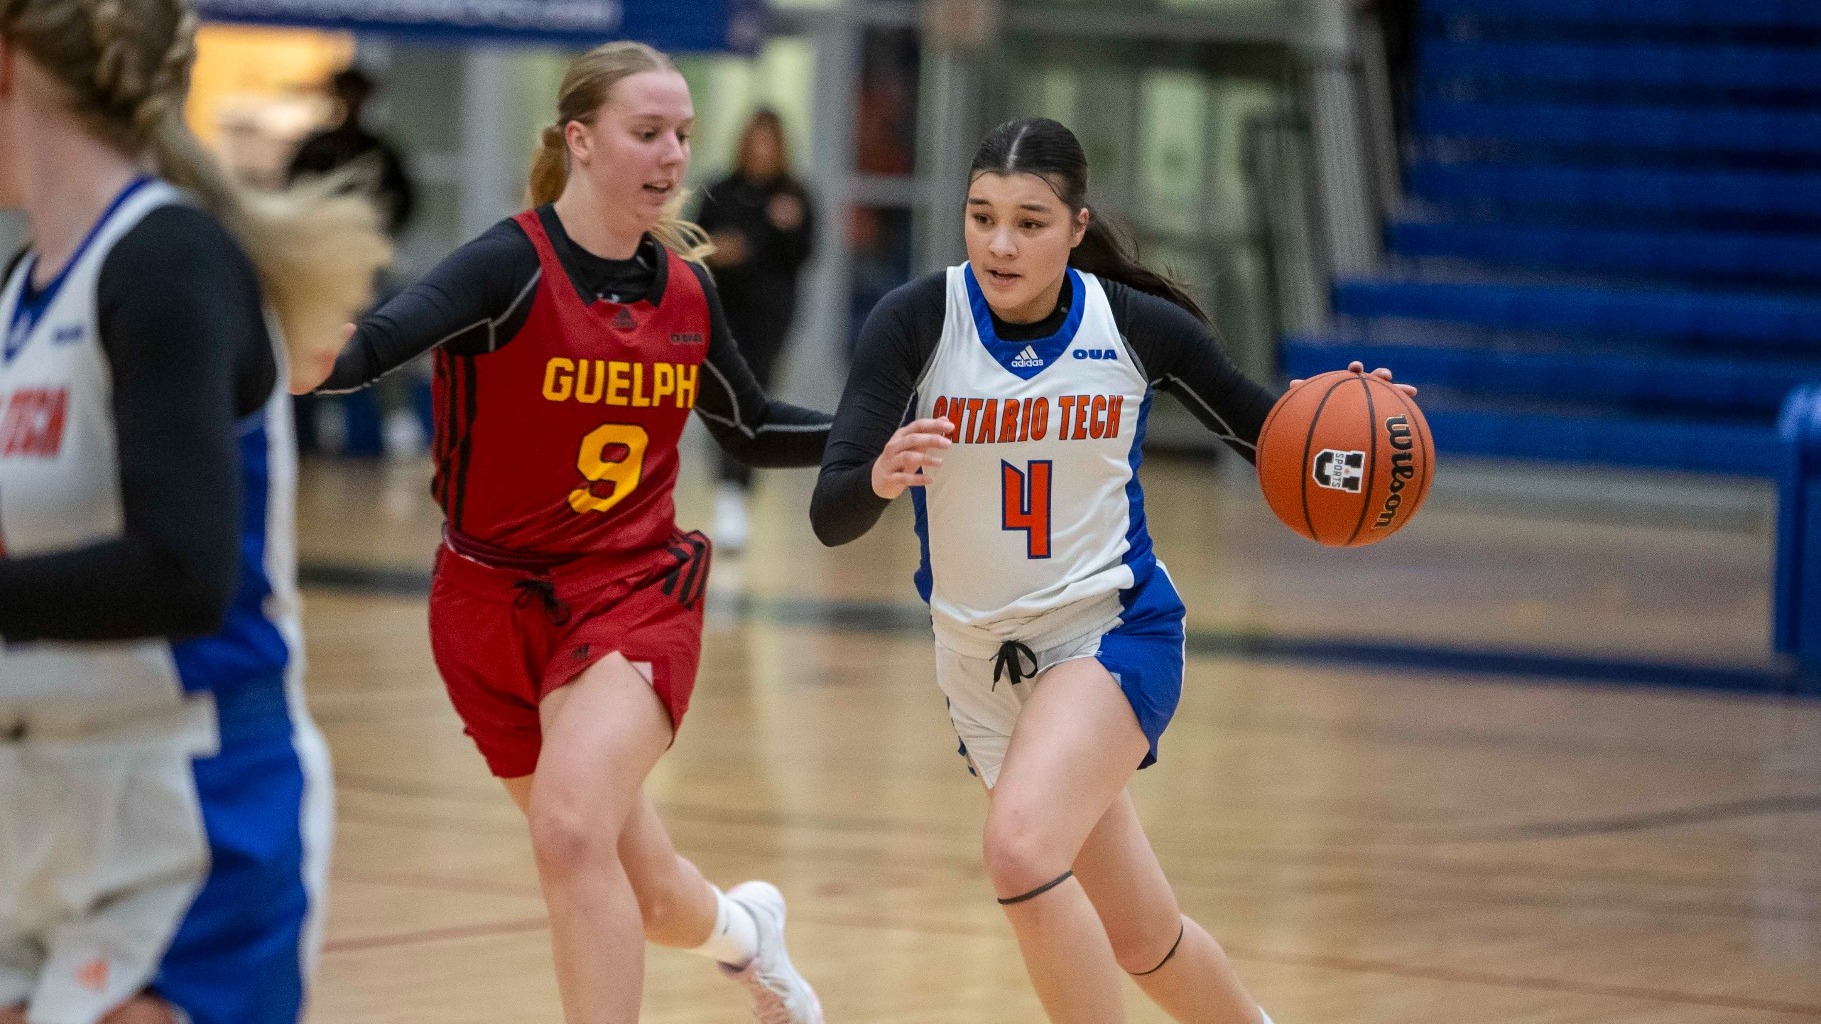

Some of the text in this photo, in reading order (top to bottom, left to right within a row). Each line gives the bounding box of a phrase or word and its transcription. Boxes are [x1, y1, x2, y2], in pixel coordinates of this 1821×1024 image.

[1011, 358, 1044, 367] adidas
[1073, 348, 1118, 360] OUA
[542, 357, 698, 409] GUELPH
[1058, 394, 1124, 440] TECH
[568, 423, 649, 514] 9
[1331, 452, 1345, 488] SPORTS
[1374, 413, 1415, 529] Wilson
[1001, 458, 1053, 560] 4
